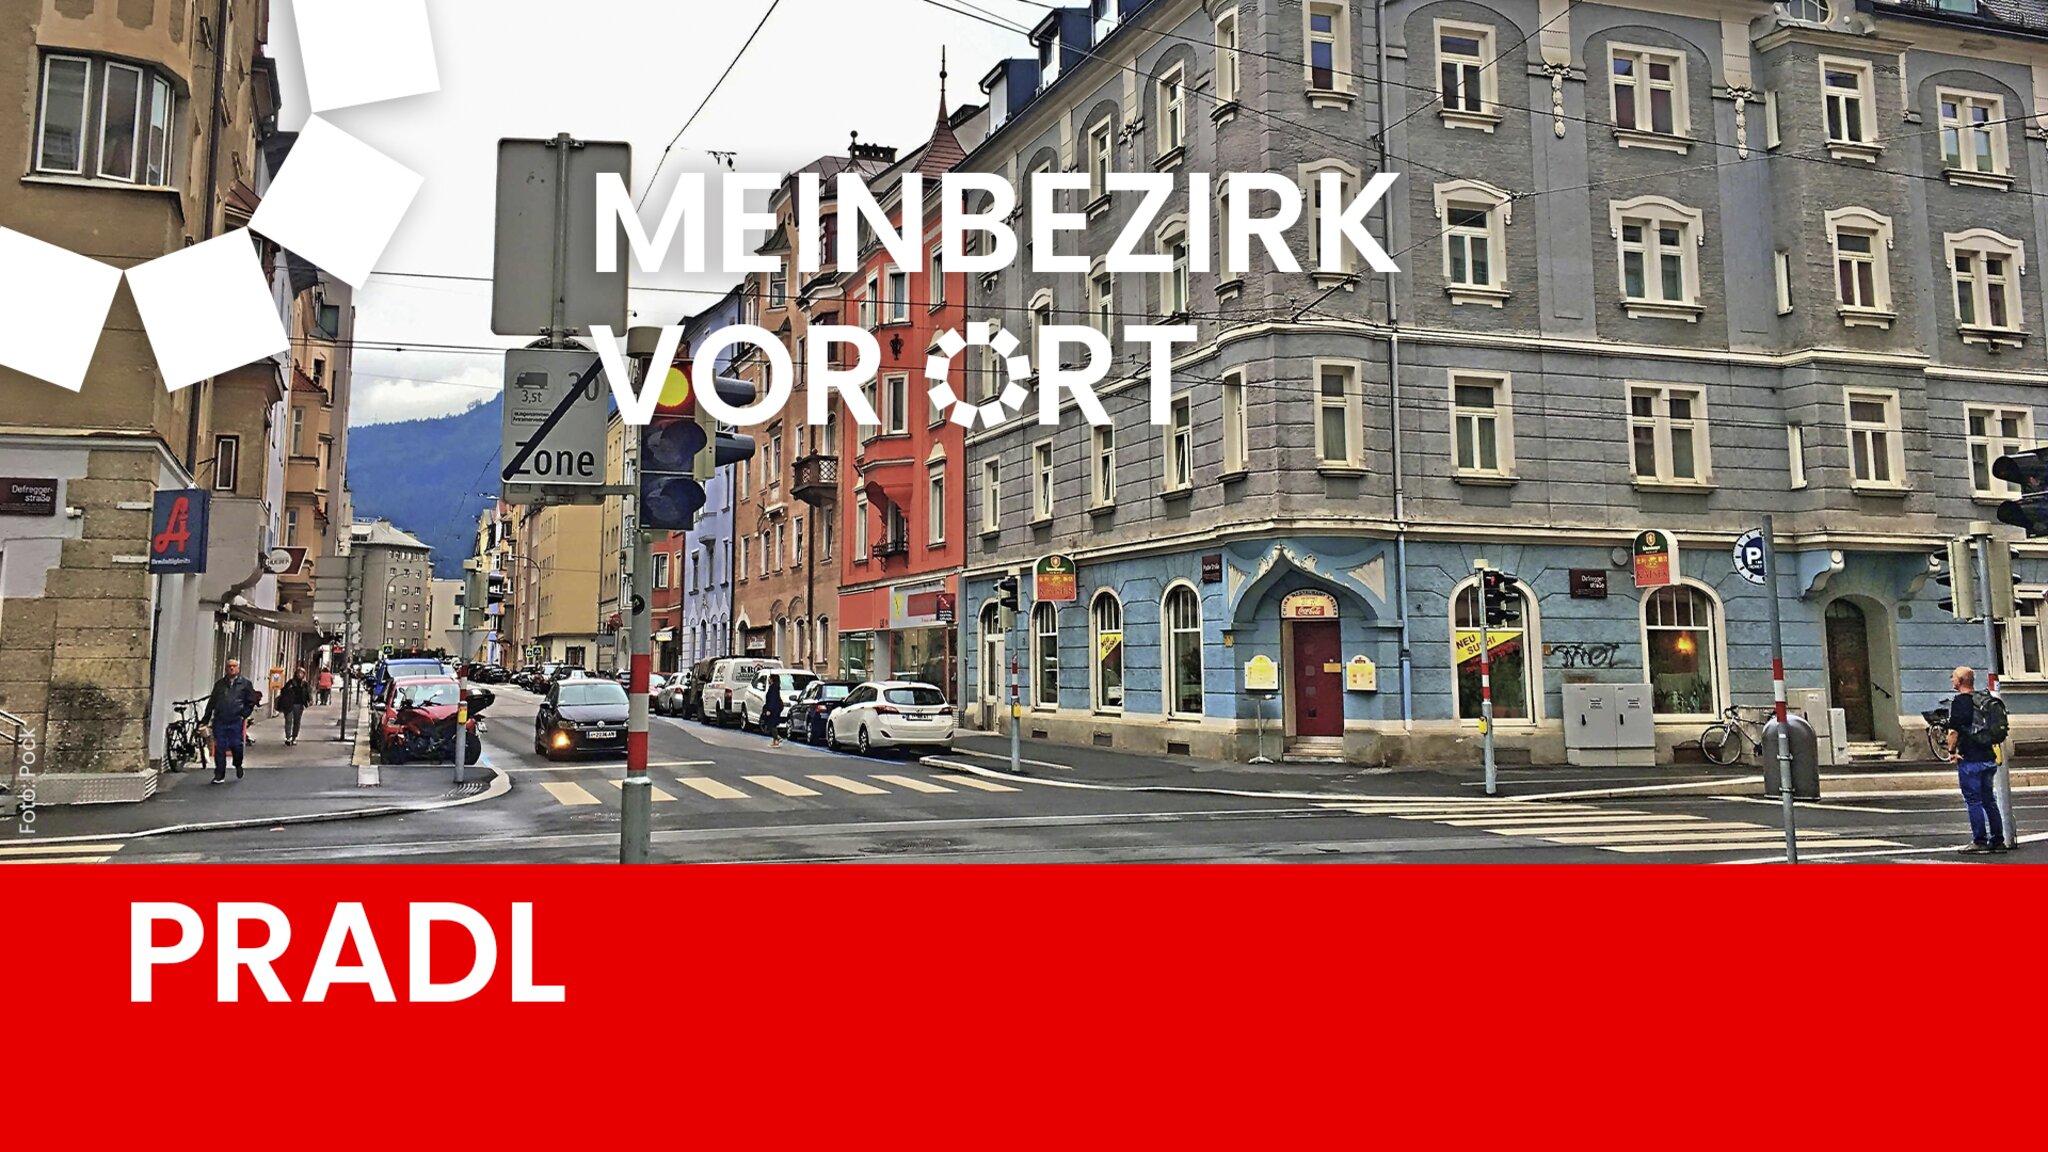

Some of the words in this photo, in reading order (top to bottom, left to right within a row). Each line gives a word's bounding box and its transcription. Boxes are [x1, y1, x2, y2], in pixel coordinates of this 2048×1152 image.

[515, 442, 595, 476] Zone
[11, 484, 54, 495] Defregger-
[24, 494, 51, 502] straße
[1746, 547, 1762, 565] P
[1456, 634, 1476, 650] NEU
[1467, 636, 1496, 655] SUHI
